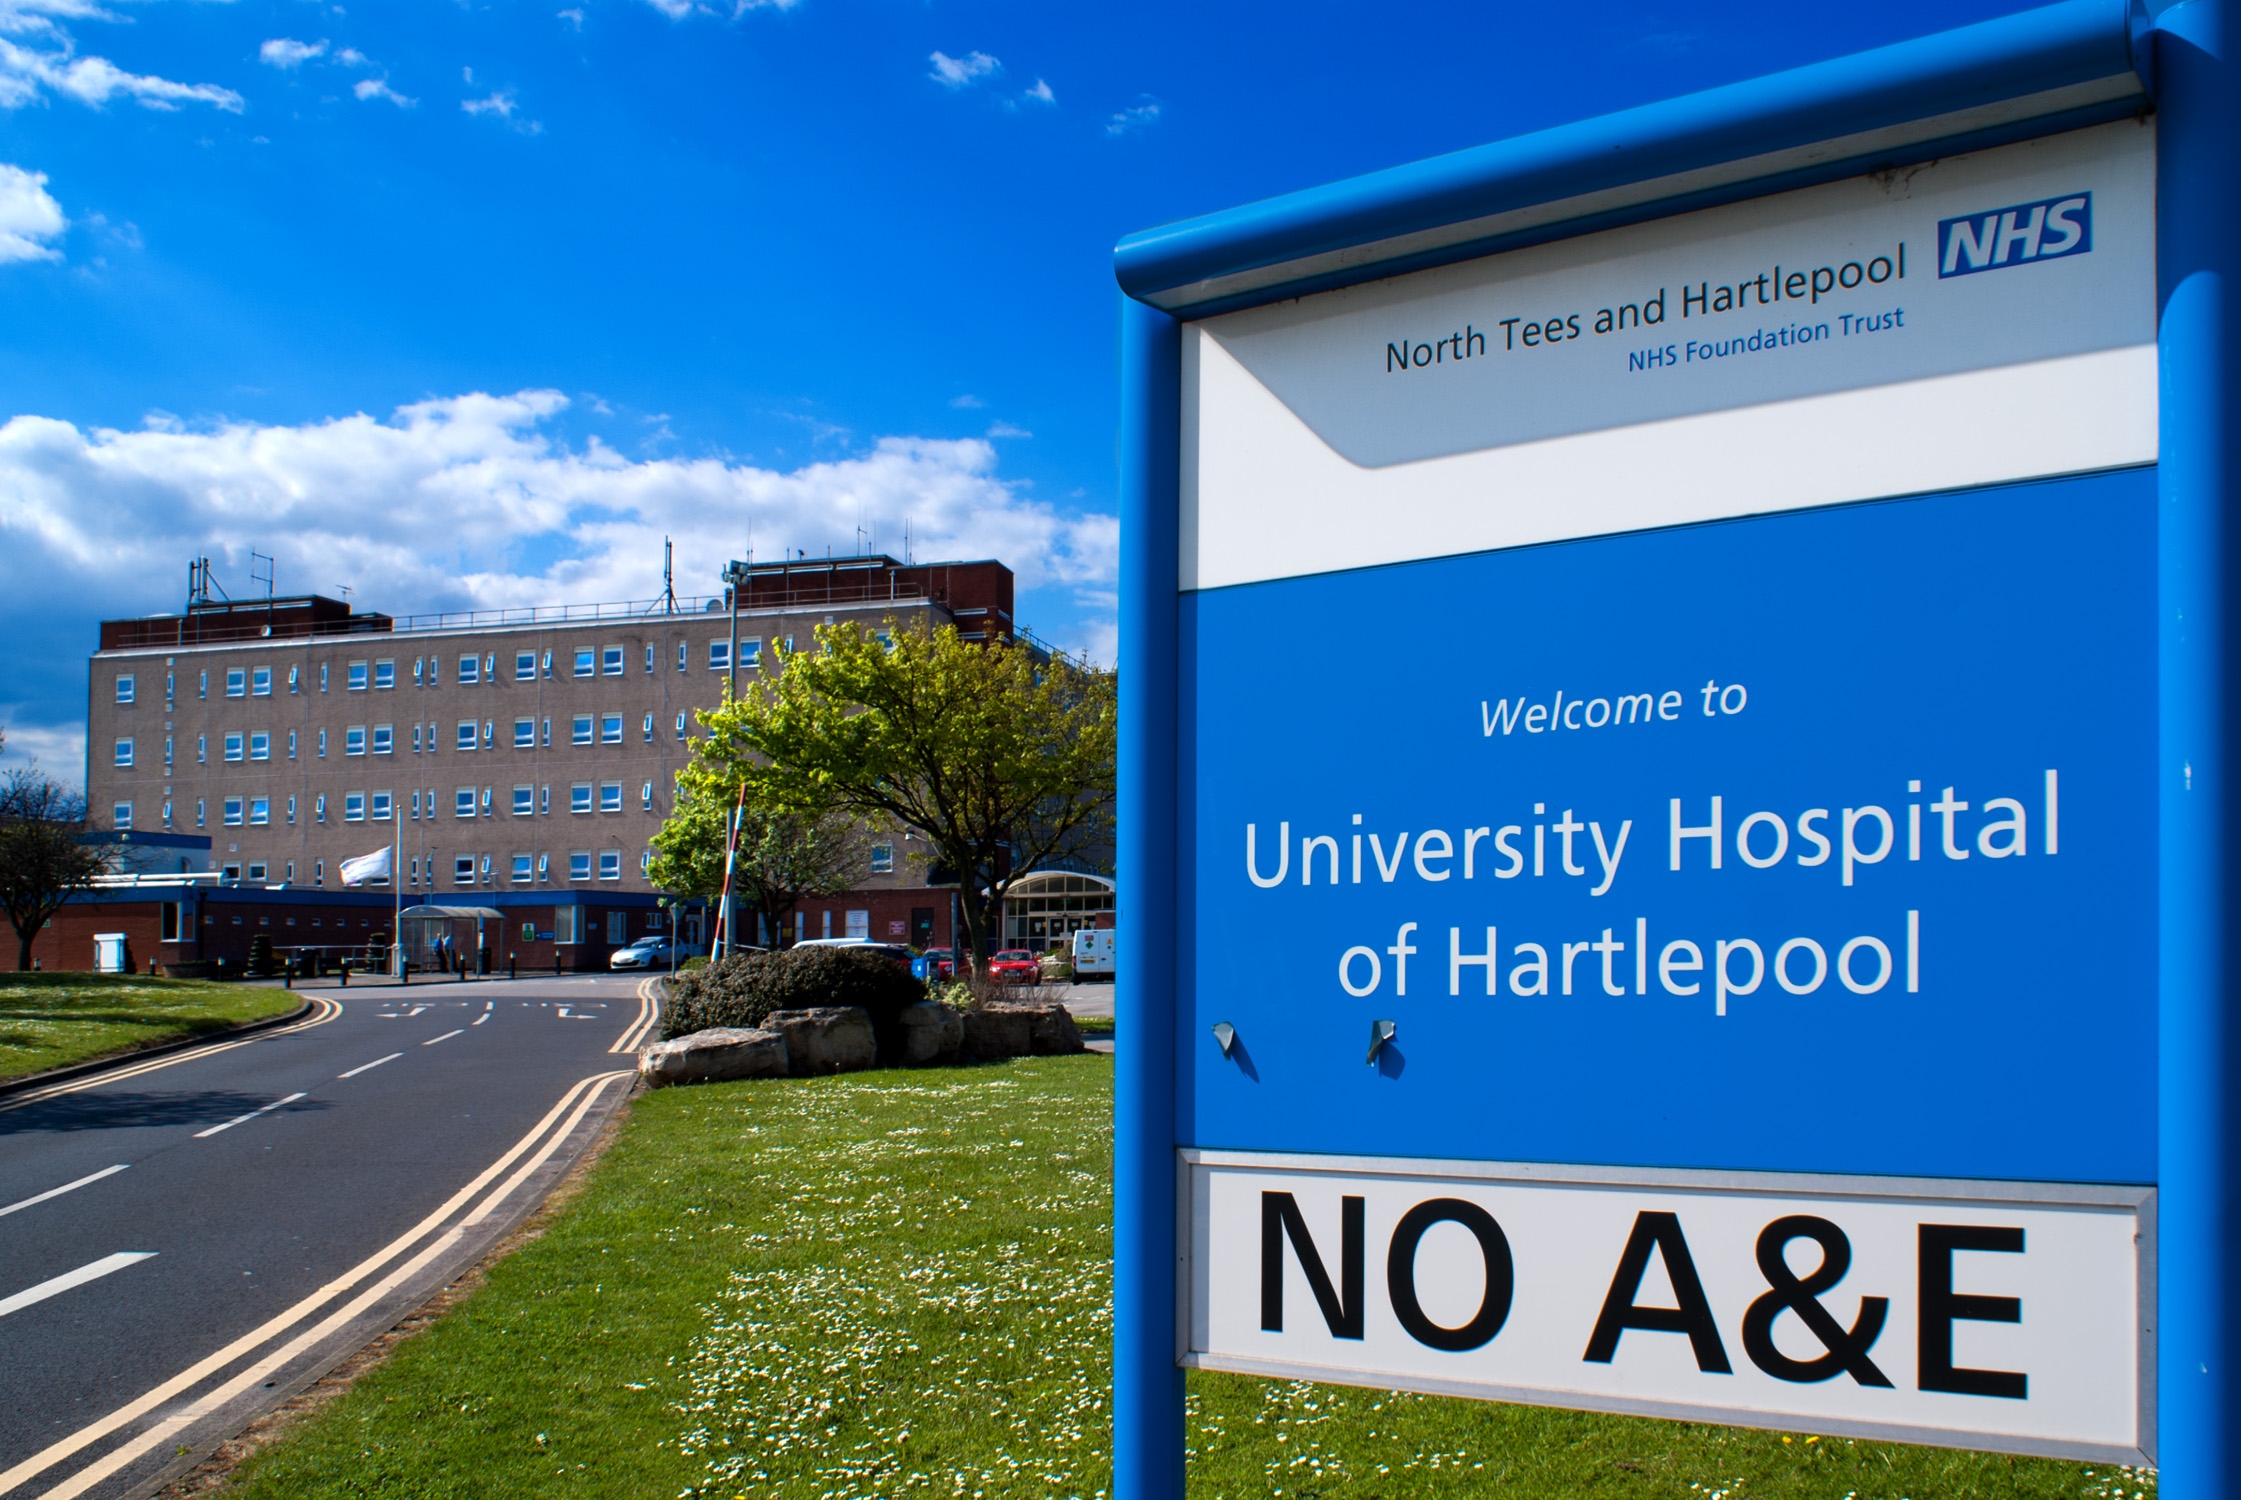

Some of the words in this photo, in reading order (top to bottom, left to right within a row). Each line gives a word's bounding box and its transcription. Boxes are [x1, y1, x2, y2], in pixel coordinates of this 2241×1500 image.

[1945, 197, 2086, 272] NHS
[1387, 324, 1486, 374] North
[1499, 313, 1582, 351] Tees
[1594, 286, 1667, 334] and
[1683, 240, 1908, 318] Hartlepool
[1629, 343, 1679, 372] NHS
[1686, 323, 1831, 363] Foundation
[1838, 307, 1905, 336] Trust
[1481, 690, 1683, 738] Welcome
[1701, 679, 1748, 717] to
[1245, 802, 1633, 897] University
[1669, 769, 2059, 887] Hospital
[1337, 921, 1418, 997] of
[1448, 909, 1920, 1017] Hartlepool
[1260, 1190, 1515, 1354] NO
[1582, 1211, 2029, 1401] A&E
